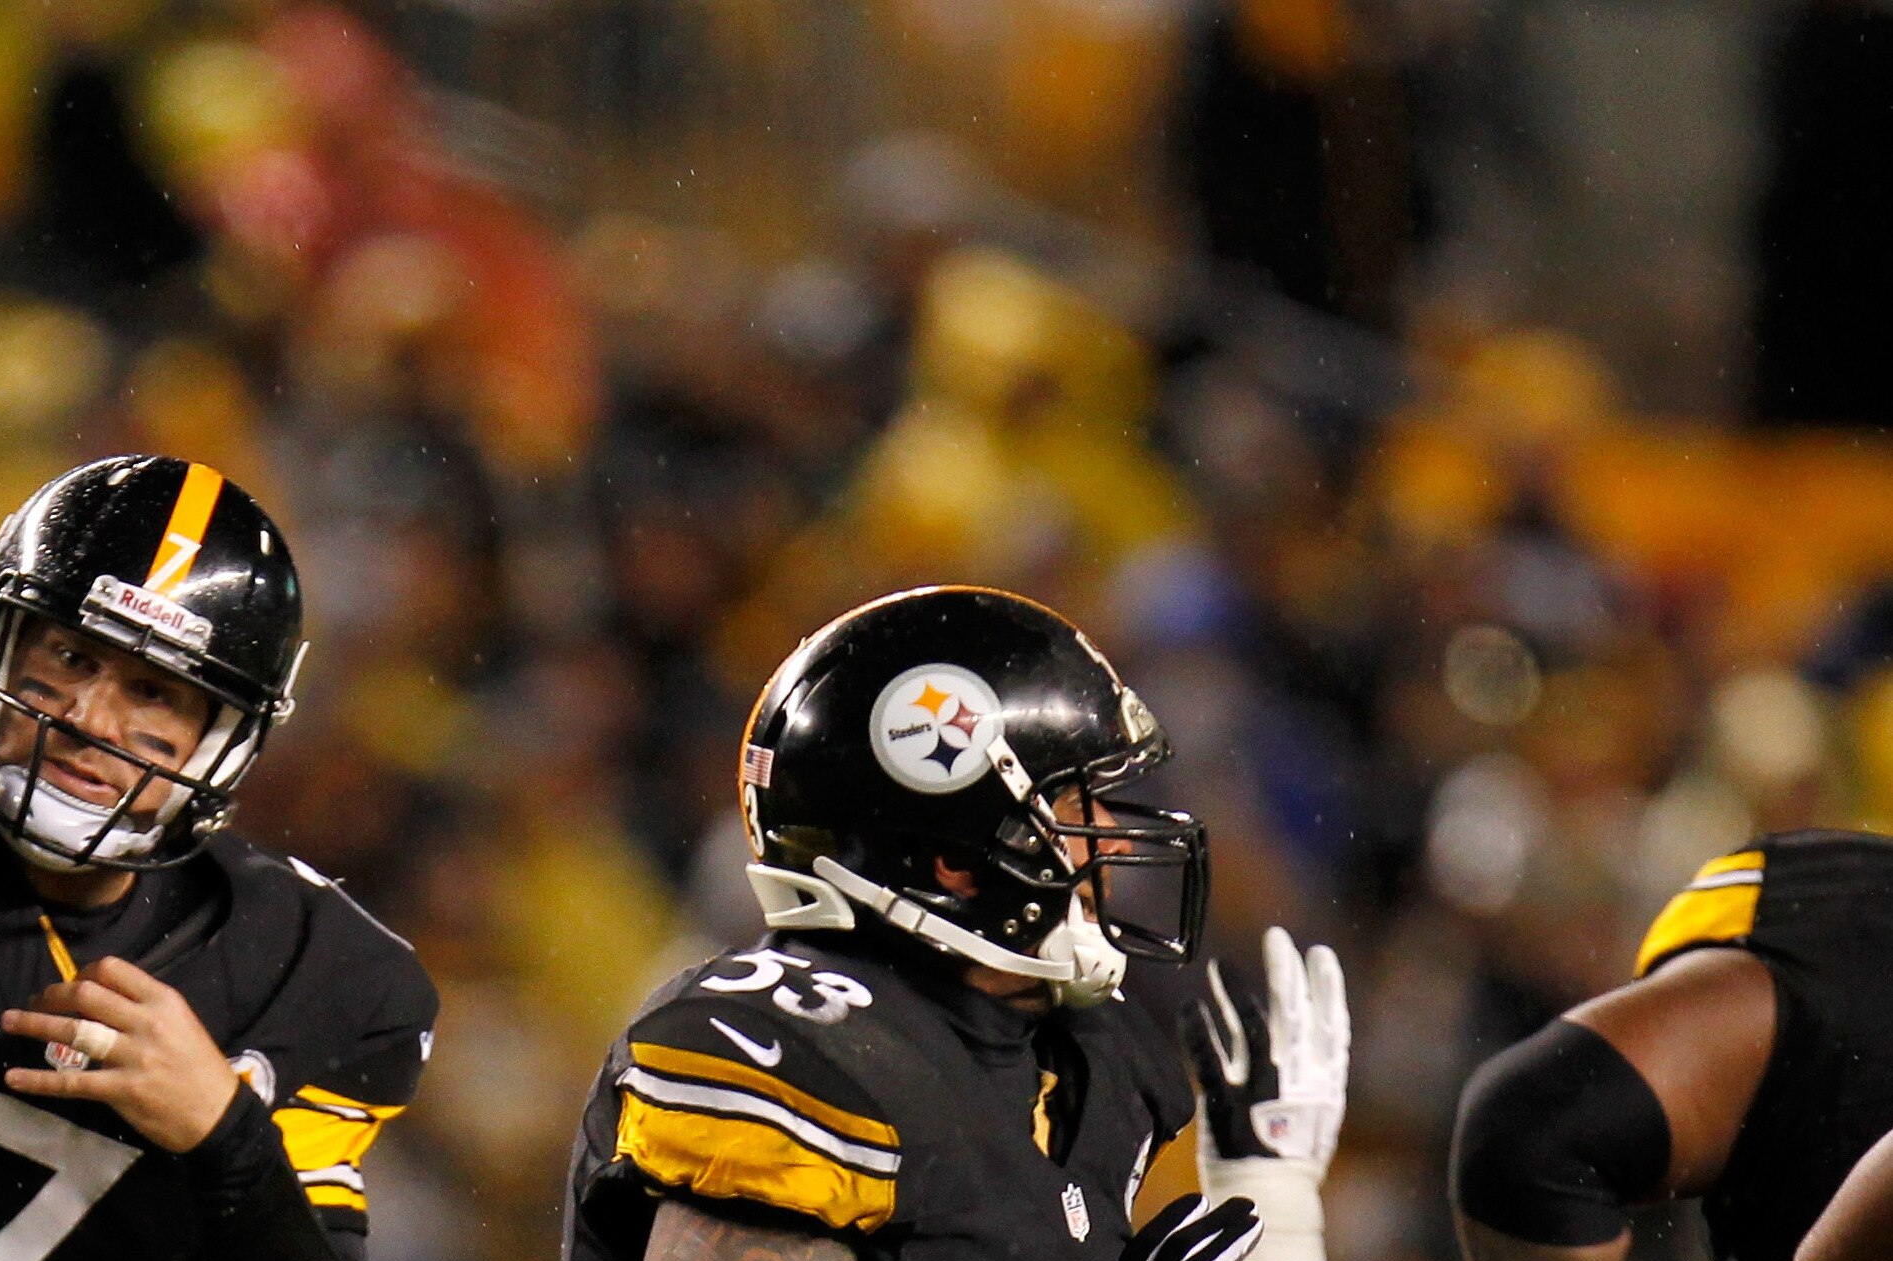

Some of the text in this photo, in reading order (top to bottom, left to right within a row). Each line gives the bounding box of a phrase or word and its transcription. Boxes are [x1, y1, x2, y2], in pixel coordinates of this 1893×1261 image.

[143, 532, 203, 590] 7
[119, 588, 186, 630] Riddell
[888, 721, 932, 741] Steelers
[699, 948, 874, 1026] 53
